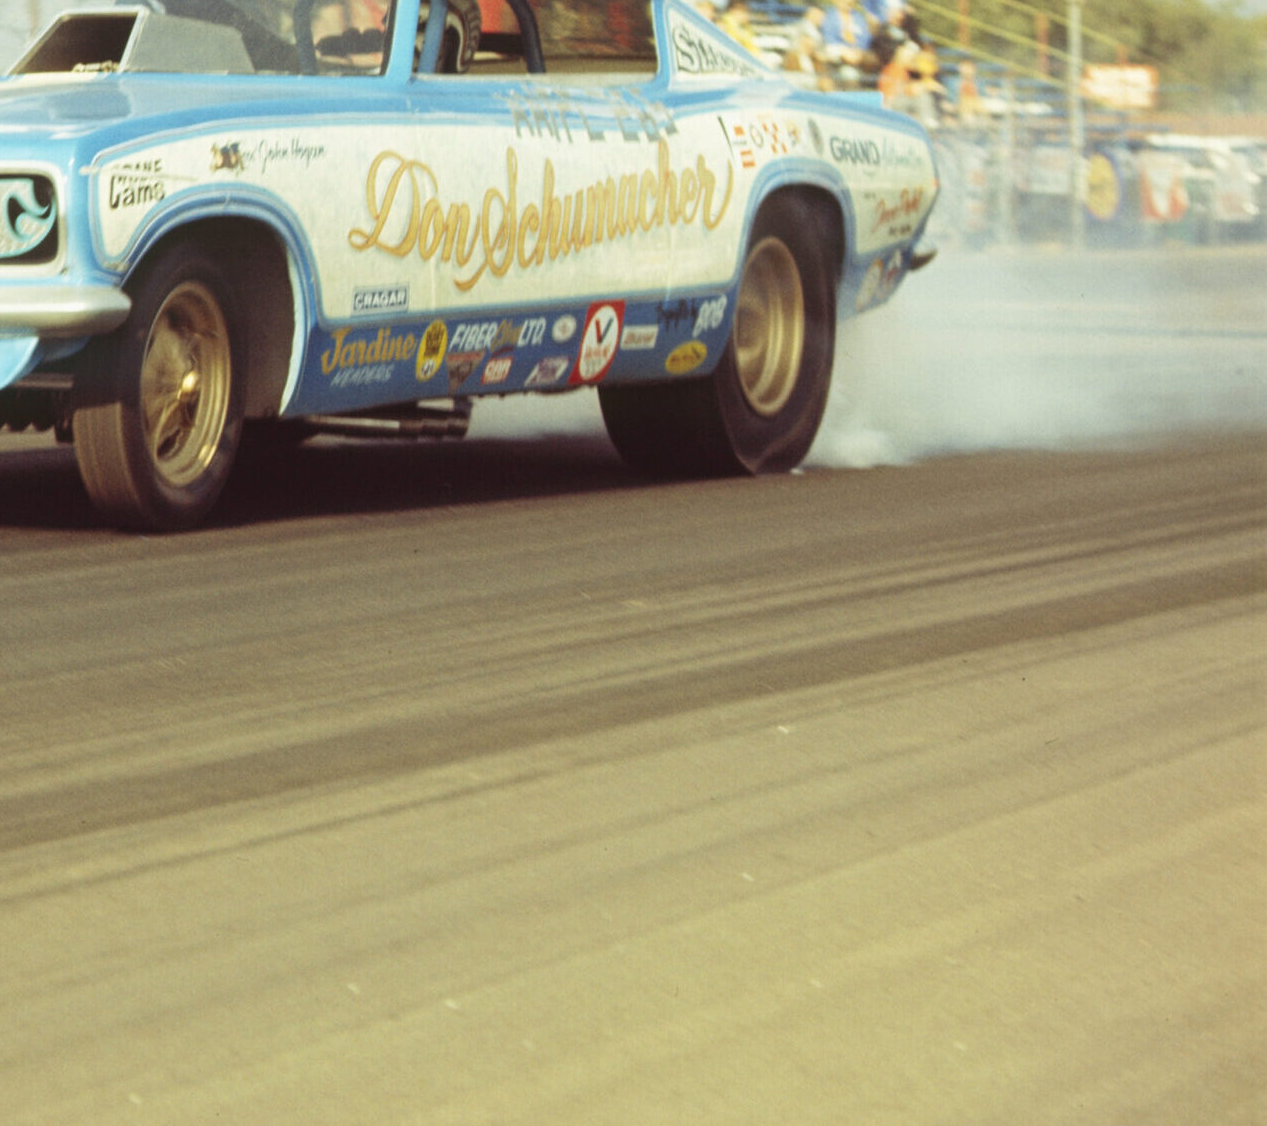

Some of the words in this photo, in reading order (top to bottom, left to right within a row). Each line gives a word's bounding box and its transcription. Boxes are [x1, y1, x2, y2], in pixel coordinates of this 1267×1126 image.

[829, 135, 881, 165] GRAND
[347, 149, 480, 268] Don
[453, 136, 734, 291] Schumacher
[321, 325, 417, 375] Jardine
[448, 321, 499, 353] FIBER
[517, 316, 547, 347] LTD
